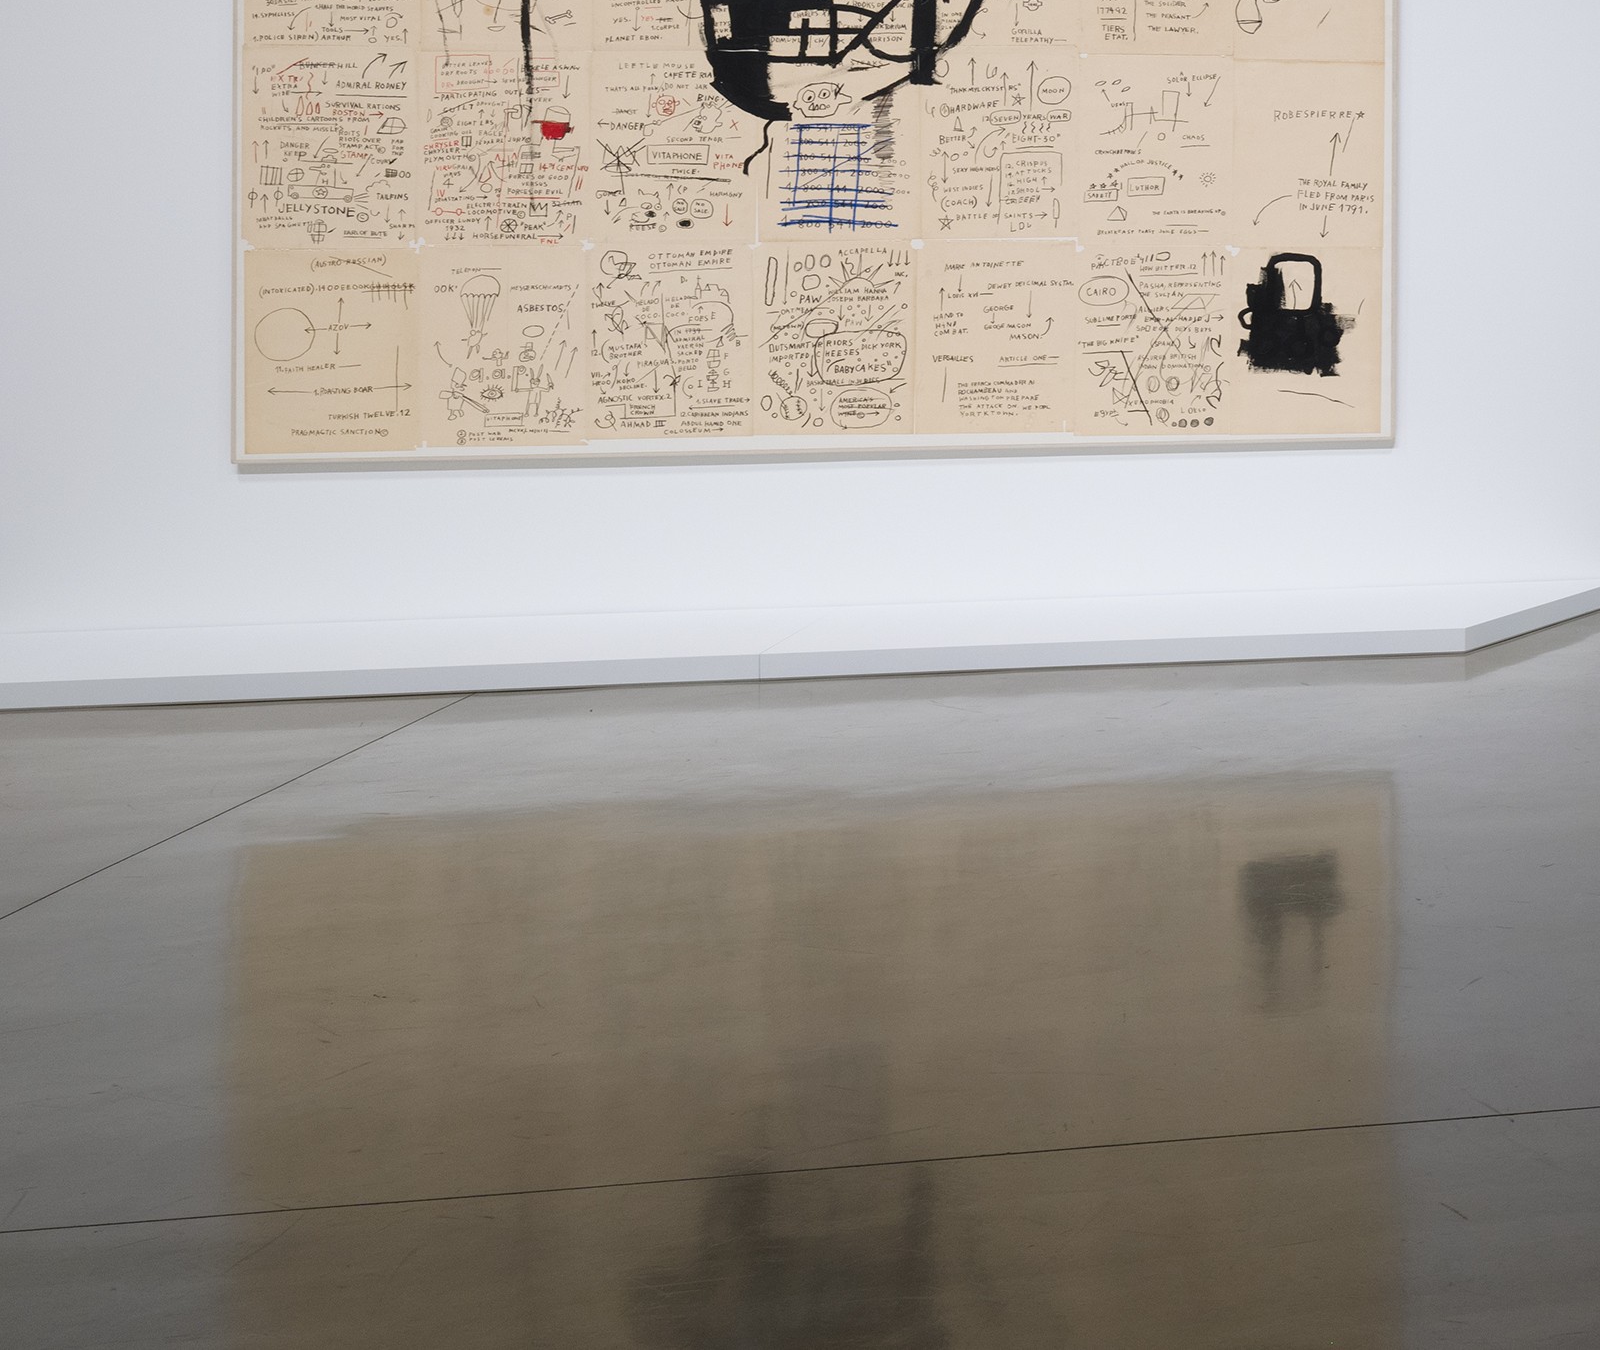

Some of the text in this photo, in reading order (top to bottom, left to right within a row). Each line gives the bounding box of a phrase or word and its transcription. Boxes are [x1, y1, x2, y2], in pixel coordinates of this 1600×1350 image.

[1102, 25, 1125, 33] TIERS
[336, 81, 371, 89] ADMIRAL
[1274, 110, 1352, 121] ROBESPIERRE
[1298, 178, 1368, 190] THE ROYAL FAMILY
[1298, 190, 1374, 202] FLED FROM PARIS
[1308, 204, 1334, 212] JUNE
[650, 261, 692, 269] OTTOMAN
[1086, 287, 1116, 297] CAIRO
[517, 304, 564, 313] ASBESTOS
